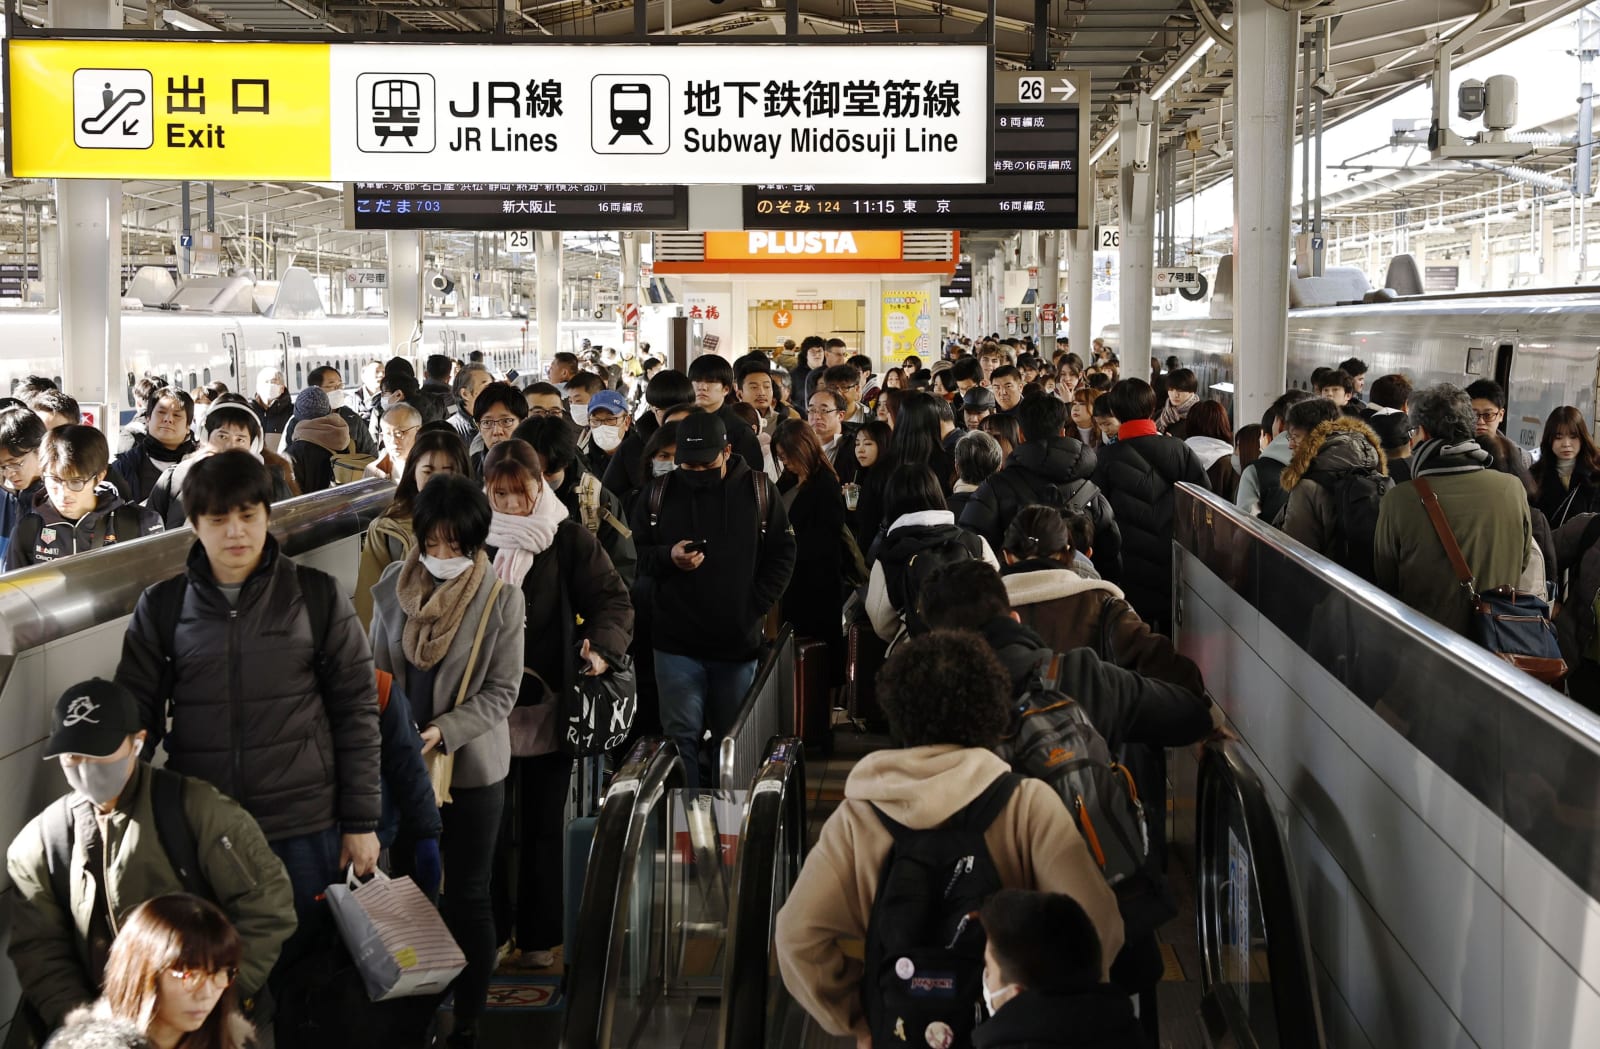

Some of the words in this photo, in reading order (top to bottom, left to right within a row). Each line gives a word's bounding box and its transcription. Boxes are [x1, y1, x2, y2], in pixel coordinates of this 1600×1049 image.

[167, 75, 270, 115] 出口
[449, 79, 563, 118] JR線
[683, 79, 961, 118] 地下鉄御堂筋線
[1020, 80, 1042, 100] 26
[167, 123, 225, 149] Exit
[449, 128, 481, 152] JR
[491, 127, 558, 152] Lines
[683, 127, 781, 159] Subway
[791, 127, 896, 159] Midōsuji
[906, 127, 958, 152] Line
[357, 199, 411, 213] こだま
[416, 201, 440, 212] 703
[502, 200, 556, 214] 新大阪止
[757, 200, 811, 213] のぞみ
[817, 202, 840, 212] 124
[852, 200, 895, 213] 11:15
[182, 236, 190, 246] 7
[510, 231, 528, 247] 25
[748, 231, 858, 254] PLUSTA
[1103, 231, 1119, 247] 26
[1314, 238, 1322, 249] 7
[358, 273, 385, 283] 7号車
[1168, 272, 1195, 283] 7号車
